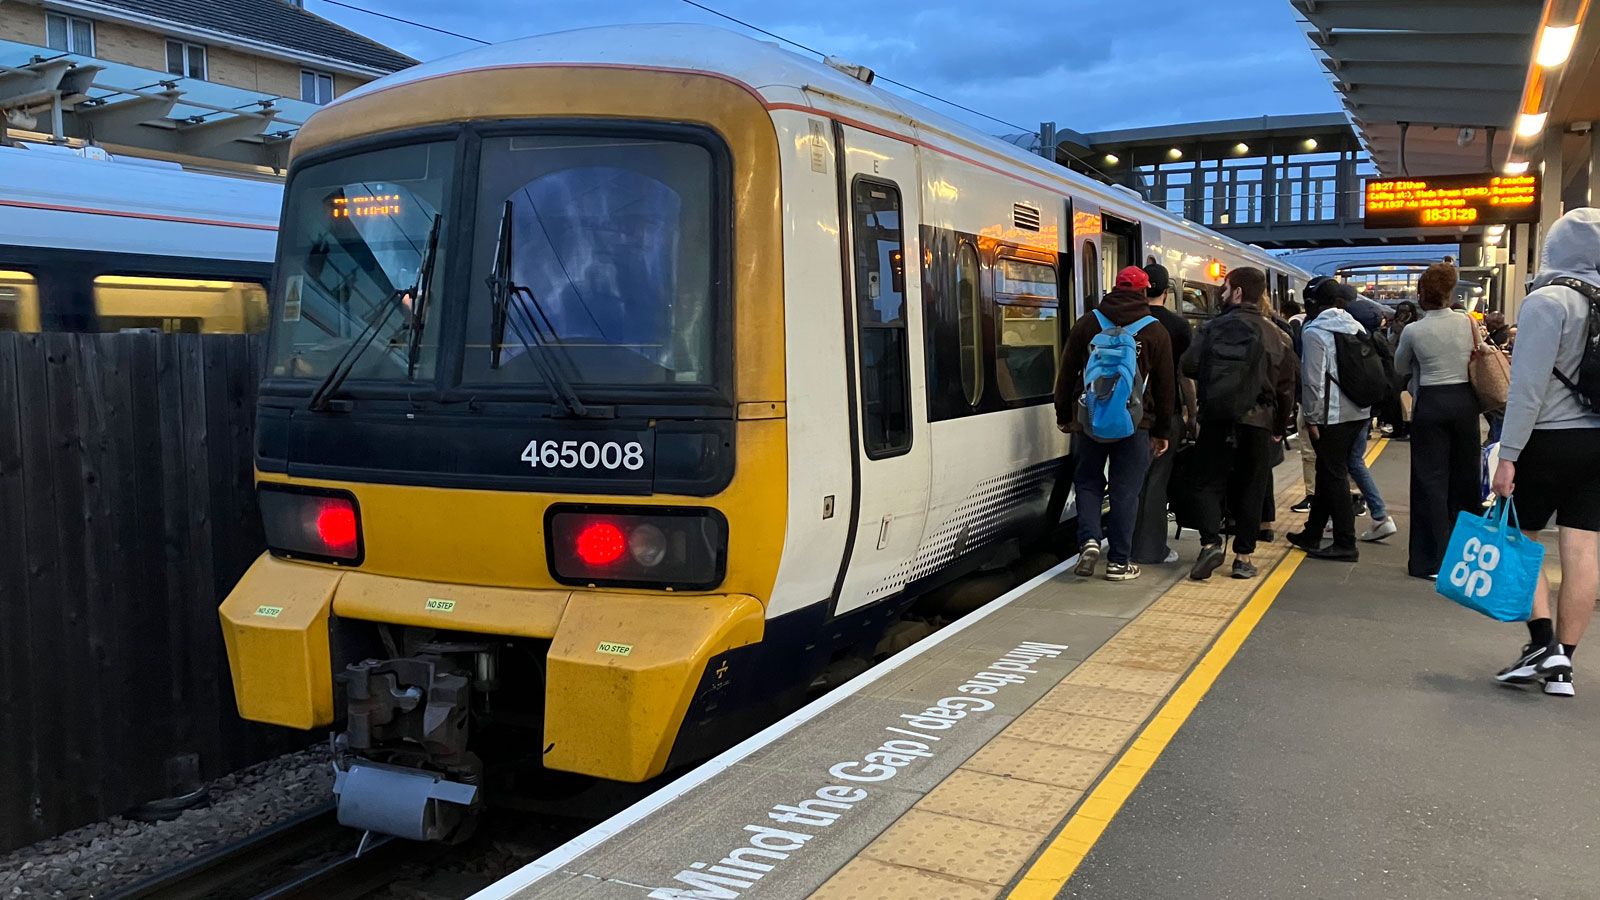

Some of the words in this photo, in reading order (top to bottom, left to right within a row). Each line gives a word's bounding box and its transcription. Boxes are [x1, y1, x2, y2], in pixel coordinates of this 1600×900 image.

[873, 160, 879, 174] E
[1396, 181, 1427, 190] Eltham
[1502, 176, 1535, 185] coaches
[1370, 192, 1394, 200] Calling
[1416, 190, 1437, 198] Slade
[1438, 189, 1461, 197] Green
[1370, 201, 1384, 209] 3rd
[1406, 200, 1419, 208] via
[1421, 199, 1441, 207] Slade
[1443, 198, 1466, 206] Green
[1501, 195, 1534, 204] coaches
[1425, 208, 1477, 221] 18:31:28
[520, 440, 644, 470] 465008
[427, 600, 437, 609] NO
[437, 601, 454, 610] STEP
[599, 643, 611, 651] NO
[610, 645, 630, 654] STEP
[987, 641, 1069, 674] Mind
[957, 671, 1027, 695] the
[900, 696, 995, 730] Gap
[648, 824, 814, 900] Mind
[768, 786, 868, 827] the
[829, 740, 934, 782] Gap
